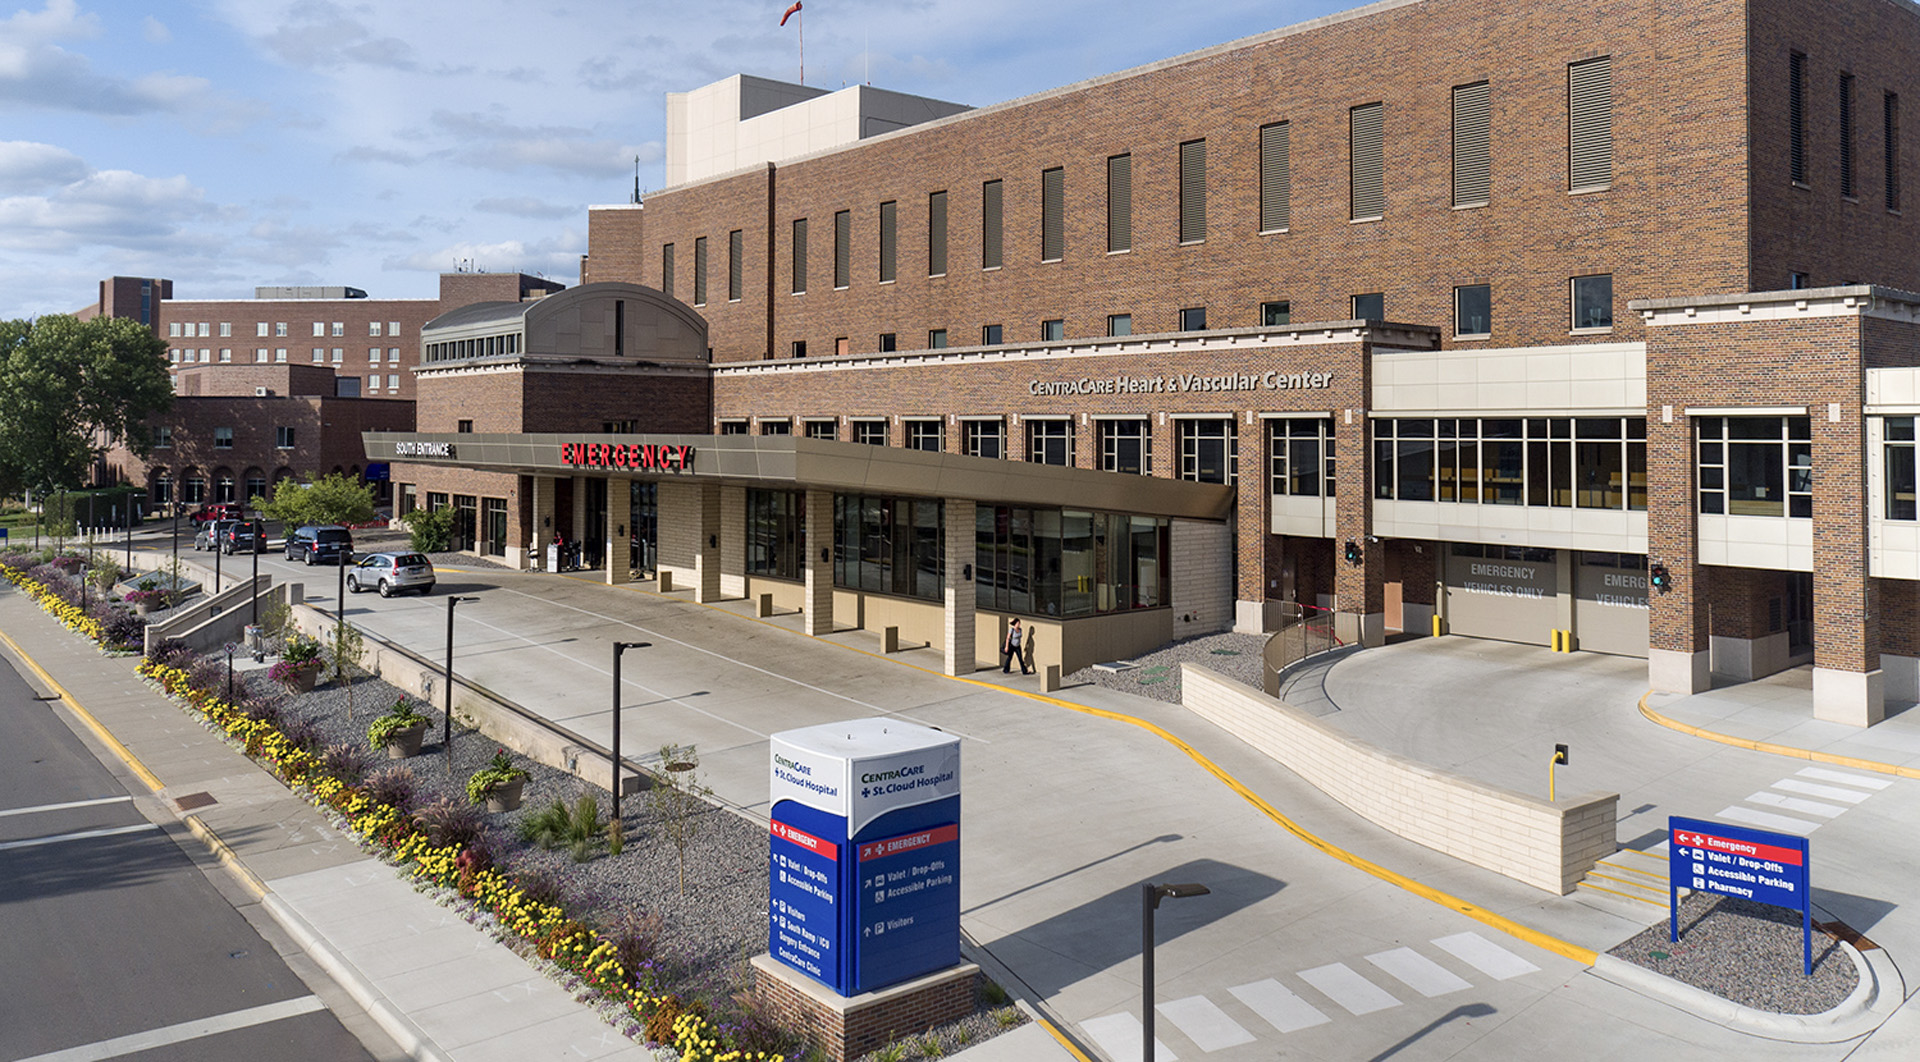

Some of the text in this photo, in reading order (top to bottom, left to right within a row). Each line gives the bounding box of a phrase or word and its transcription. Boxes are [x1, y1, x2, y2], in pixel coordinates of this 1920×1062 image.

[1116, 376, 1164, 394] Heart
[1166, 379, 1178, 393] &
[1179, 372, 1260, 392] Vascular
[1263, 371, 1333, 390] Center
[396, 442, 449, 456] SOUTH ENTRANCE
[561, 443, 689, 470] EMERGENCY
[1471, 563, 1536, 579] EMERGENCY
[1604, 573, 1648, 590] EMERG
[1463, 581, 1544, 600] VEHICLES ONLY
[786, 773, 804, 787] Cloud
[805, 780, 838, 797] Hospital
[872, 771, 954, 796] St. Cloud Hospital
[788, 829, 818, 849] EMERGENCY
[887, 833, 931, 852] EMERGENCY
[1707, 837, 1757, 855] Emergency
[788, 858, 801, 872] Valet
[804, 865, 828, 885] Drop-Offs
[887, 870, 906, 882] Valet
[911, 860, 945, 876] Drop-Offs
[1707, 851, 1731, 864] Valet
[1738, 857, 1784, 873] Drop-Offs
[787, 873, 834, 905] Accessible Parking
[887, 874, 952, 898] Accessible Parking
[1708, 866, 1795, 892] Accessible Parking
[1708, 880, 1753, 898] Pharmacy
[787, 905, 806, 922] Visitors
[887, 916, 914, 930] Visitors
[779, 930, 820, 960] Surgery Entrance
[787, 920, 801, 935] South
[802, 927, 816, 944] Ramp
[819, 937, 830, 950] ICU
[779, 946, 821, 977] CentraCare Clinic
